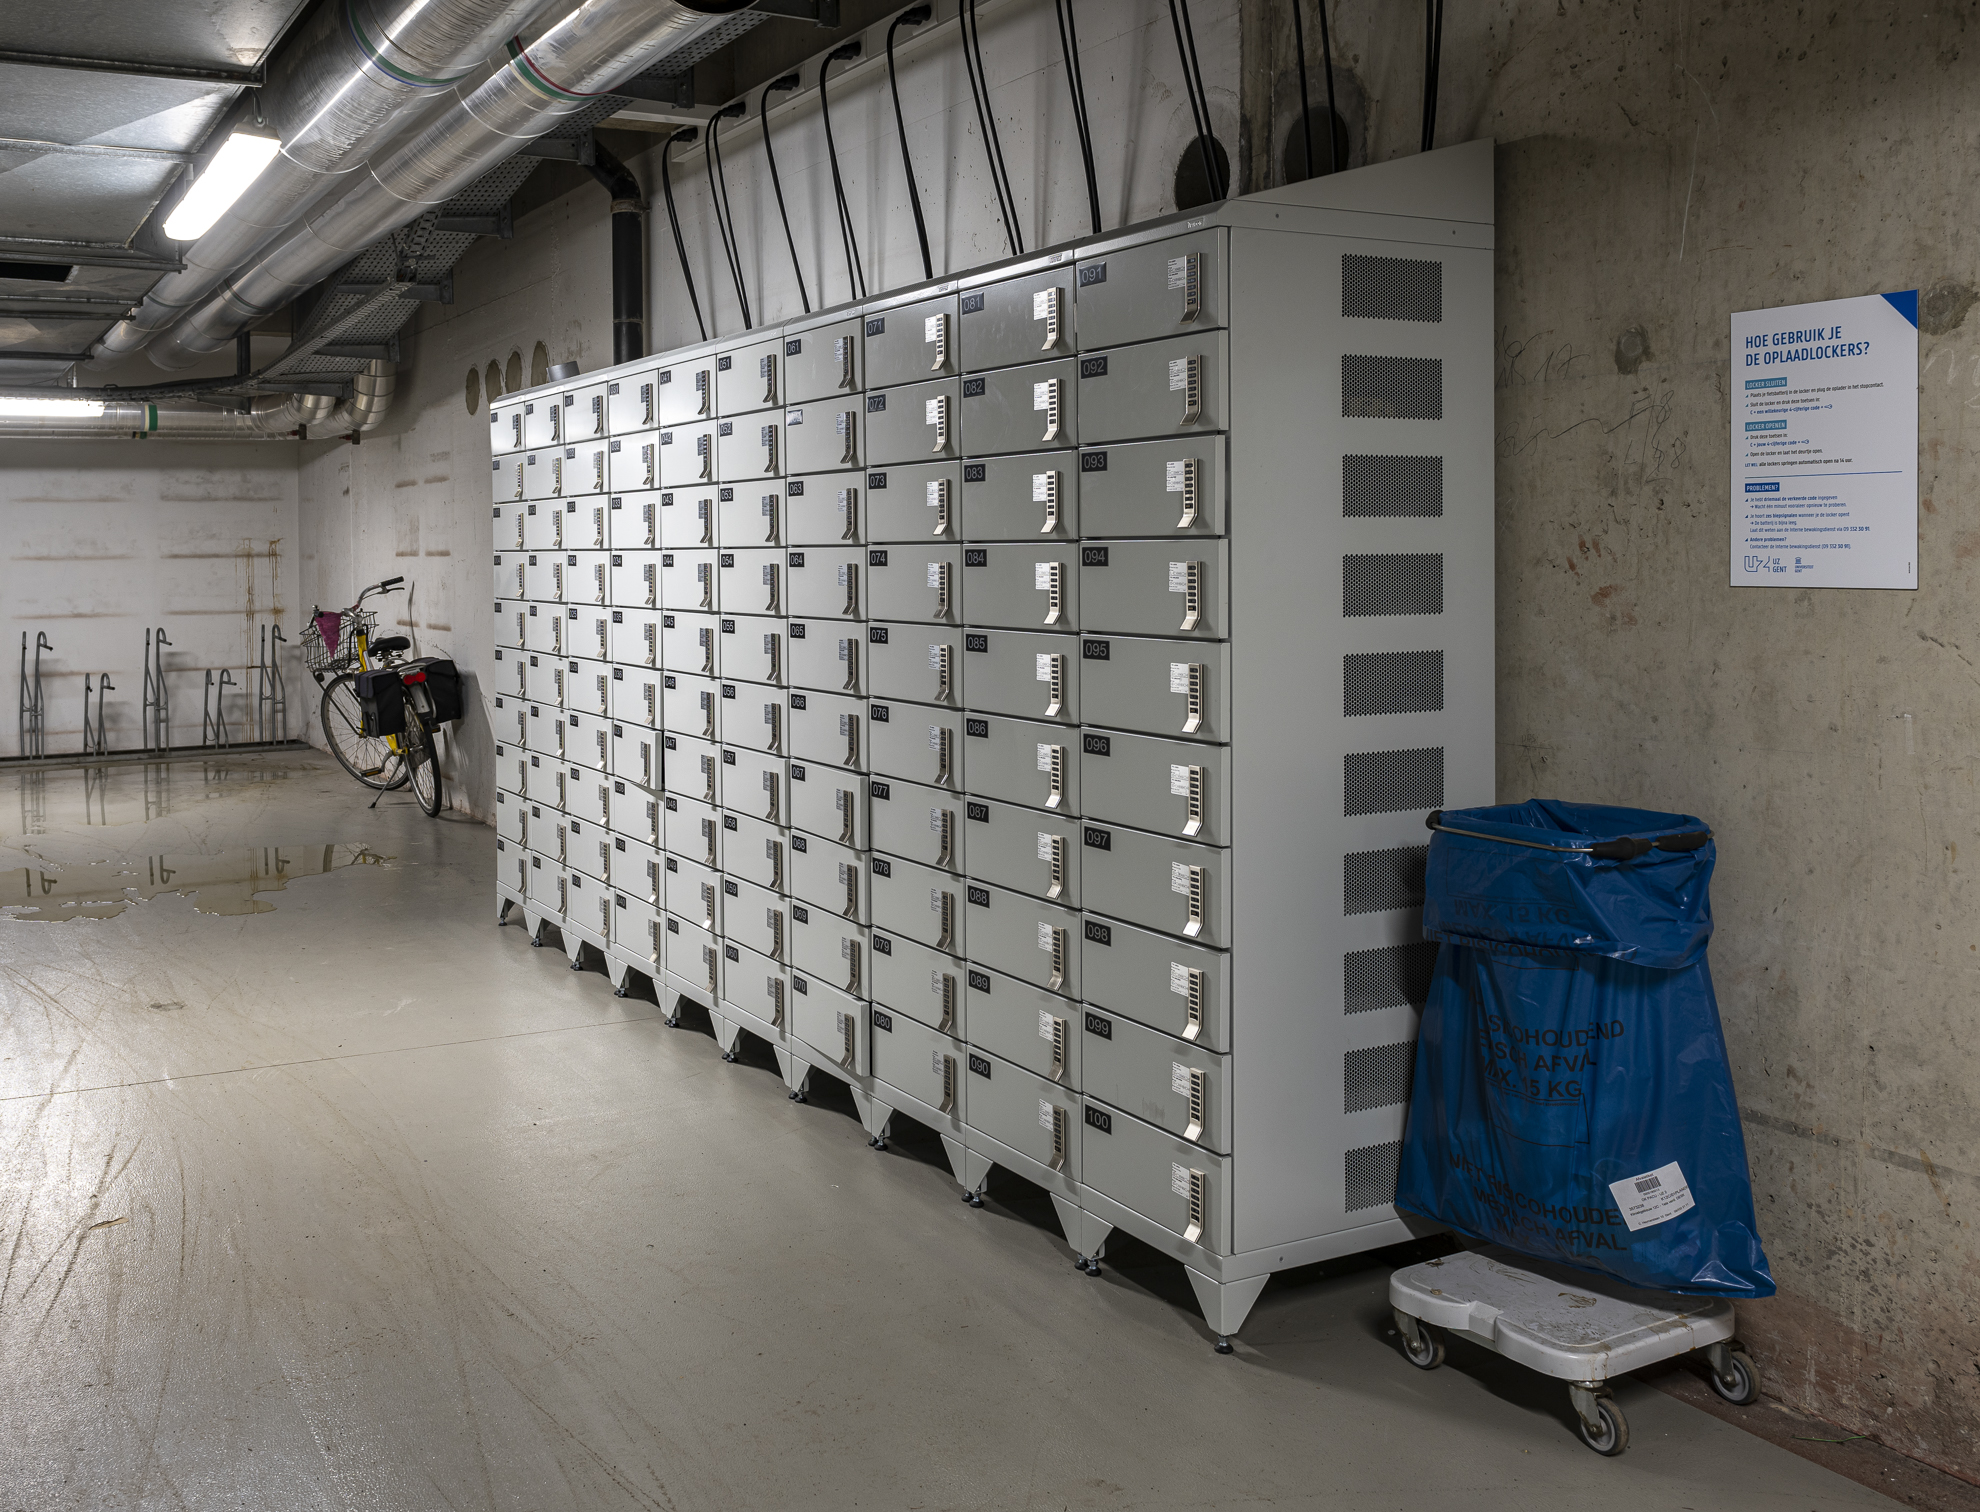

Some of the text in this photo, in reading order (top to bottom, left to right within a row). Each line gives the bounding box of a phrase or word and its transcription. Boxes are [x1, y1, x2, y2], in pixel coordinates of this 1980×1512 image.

[1081, 266, 1101, 283] 091
[964, 295, 980, 311] 081
[868, 320, 882, 334] 071
[1746, 326, 1842, 349] HOE GEBRUIK JE
[787, 342, 799, 354] 061
[1746, 342, 1870, 366] DE OPLAADLOCKERS?
[720, 358, 730, 370] 051
[1083, 359, 1104, 375] 092
[965, 380, 983, 395] 082
[869, 397, 884, 411] 072
[1084, 454, 1105, 469] 093
[966, 466, 983, 480] 083
[870, 475, 885, 487] 073
[721, 489, 732, 500] 053
[789, 483, 802, 494] 063
[722, 556, 733, 566] 054
[790, 554, 803, 565] 064
[871, 552, 886, 564] 074
[967, 552, 985, 564] 084
[1084, 550, 1106, 563] 094
[722, 621, 734, 631] 055
[791, 625, 804, 636] 065
[871, 629, 886, 641] 075
[968, 636, 986, 649] 085
[1085, 642, 1107, 657] 095
[724, 686, 735, 697] 056
[792, 696, 805, 708] 066
[872, 707, 887, 719] 076
[968, 721, 986, 735] 086
[1086, 737, 1107, 752] 096
[792, 766, 804, 778] 067
[873, 784, 888, 796] 077
[969, 805, 986, 819] 087
[725, 817, 736, 829] 058
[793, 837, 805, 850] 068
[1086, 830, 1108, 846] 097
[874, 860, 889, 875] 078
[726, 882, 737, 894] 059
[970, 889, 987, 904] 088
[794, 908, 807, 921] 069
[1087, 924, 1108, 941] 098
[874, 937, 890, 952] 079
[794, 978, 806, 992] 070
[970, 973, 988, 989] 089
[875, 1013, 890, 1029] 080
[1087, 1016, 1109, 1035] 099
[1488, 1014, 1624, 1048] SICOHOUDEND
[971, 1057, 989, 1075] 090
[1522, 1076, 1540, 1096] 15
[1548, 1080, 1581, 1098] KG
[1088, 1110, 1109, 1129] 100
[1450, 1151, 1627, 1226] NIET RISICOHOUDE
[1473, 1186, 1627, 1250] MEDISCH AFVAL
